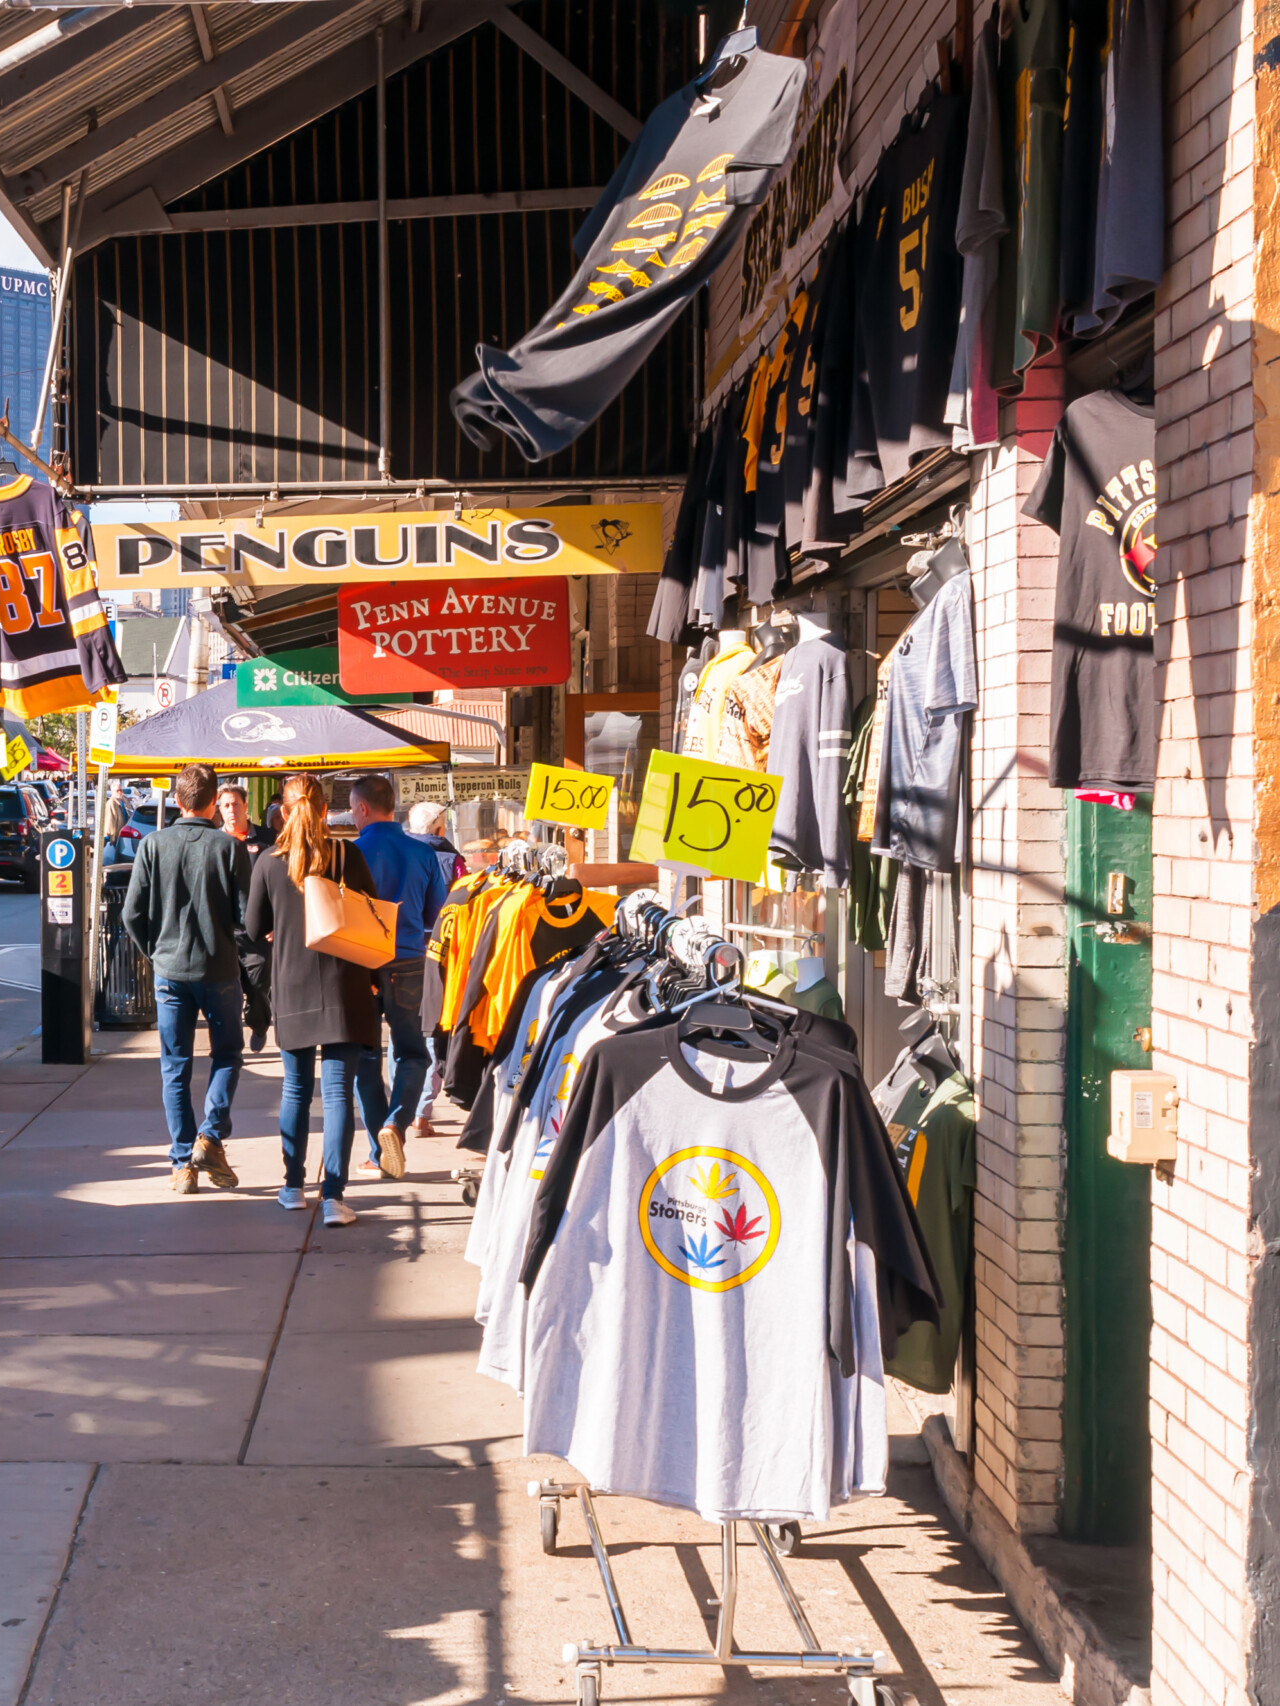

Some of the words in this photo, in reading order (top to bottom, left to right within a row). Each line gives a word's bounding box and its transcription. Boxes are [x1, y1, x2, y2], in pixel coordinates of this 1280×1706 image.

[0, 275, 47, 297] UPMC
[62, 541, 89, 572] 8
[116, 518, 563, 578] PENGUINS
[351, 598, 430, 630] PENN
[440, 587, 557, 621] AVENUE
[372, 624, 536, 658] POTTERY
[101, 712, 109, 726] P
[415, 781, 447, 793] Atomic
[498, 779, 521, 789] Rolls
[540, 776, 608, 811] 15.00
[54, 843, 69, 865] P
[55, 873, 68, 889] 2
[649, 1201, 707, 1228] Stoners
[667, 1197, 707, 1213] Pittsburgh
